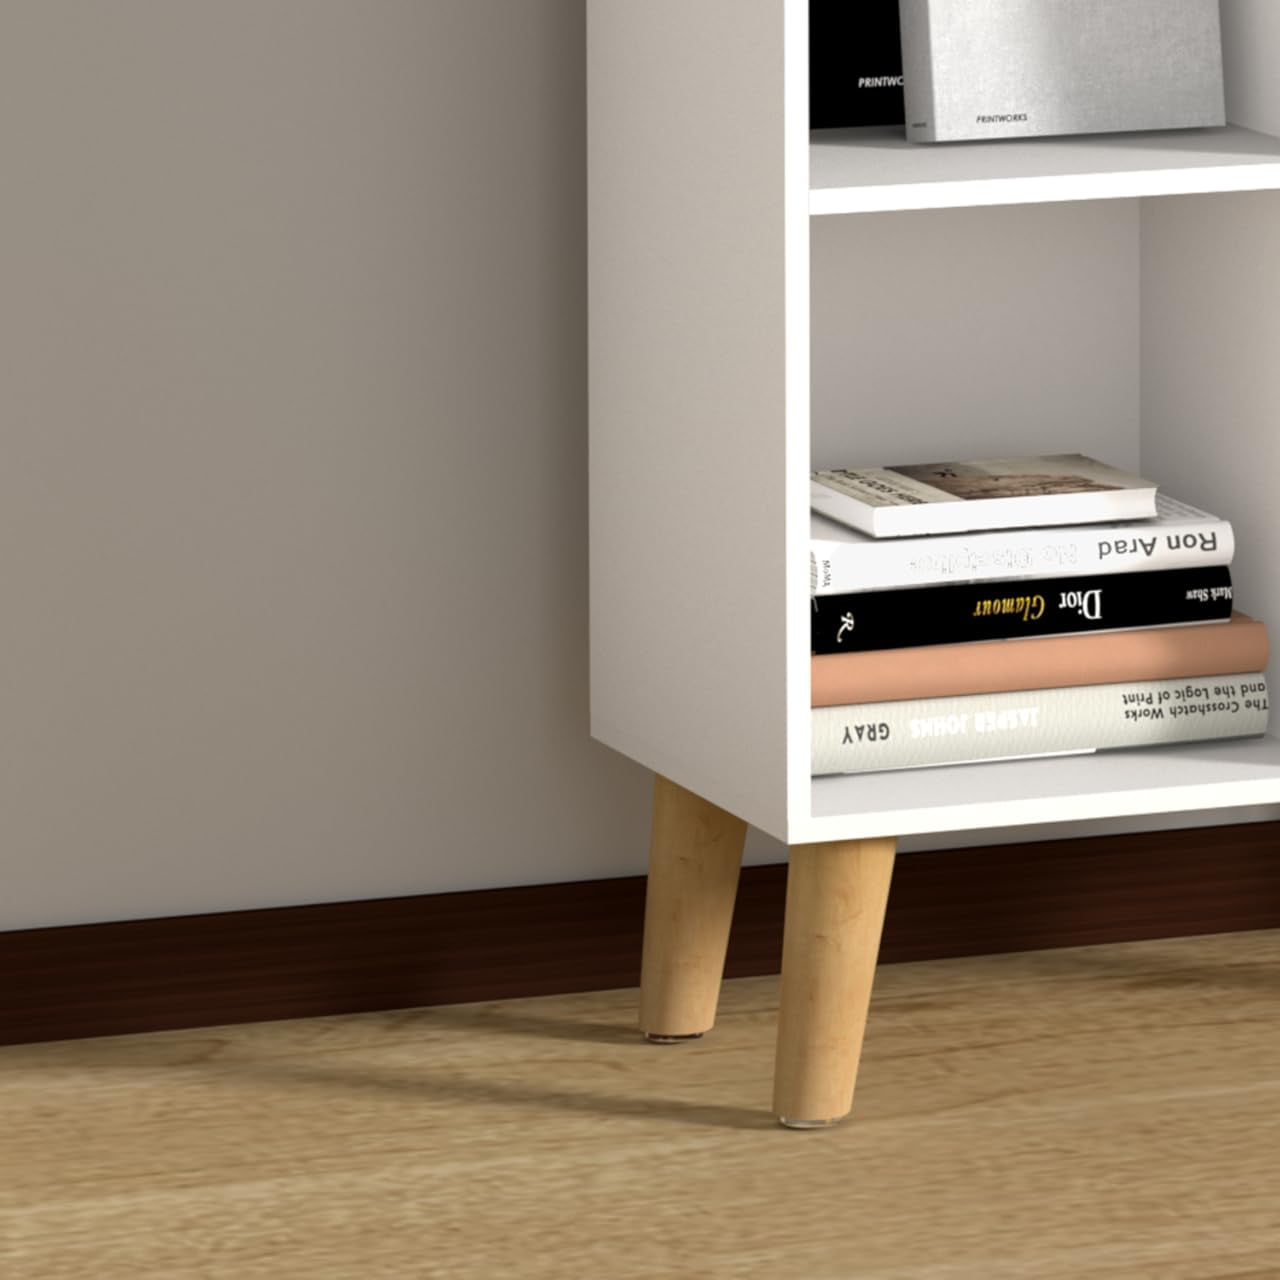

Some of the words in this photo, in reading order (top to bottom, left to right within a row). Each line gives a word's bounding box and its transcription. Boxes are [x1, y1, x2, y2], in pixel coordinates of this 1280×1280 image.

[858, 75, 904, 89] PRINTWO
[976, 113, 1028, 124] PRINTWORKS
[1098, 537, 1157, 560] Arad
[1167, 532, 1217, 552] Ron
[1185, 588, 1208, 602] Shaw
[1211, 586, 1232, 601] Mark
[972, 594, 1045, 621] Glamour
[1058, 589, 1102, 620] Dior
[1175, 685, 1209, 702] Logic
[1214, 686, 1236, 696] the
[1241, 682, 1265, 694] and
[1122, 693, 1153, 706] Print
[1158, 691, 1170, 704] of
[1245, 698, 1269, 711] The
[1125, 707, 1164, 721] Works
[1170, 701, 1239, 718] Crosshatch
[910, 712, 968, 738] JOHNS
[975, 708, 1039, 732] JASPER
[842, 722, 890, 744] GRAY
